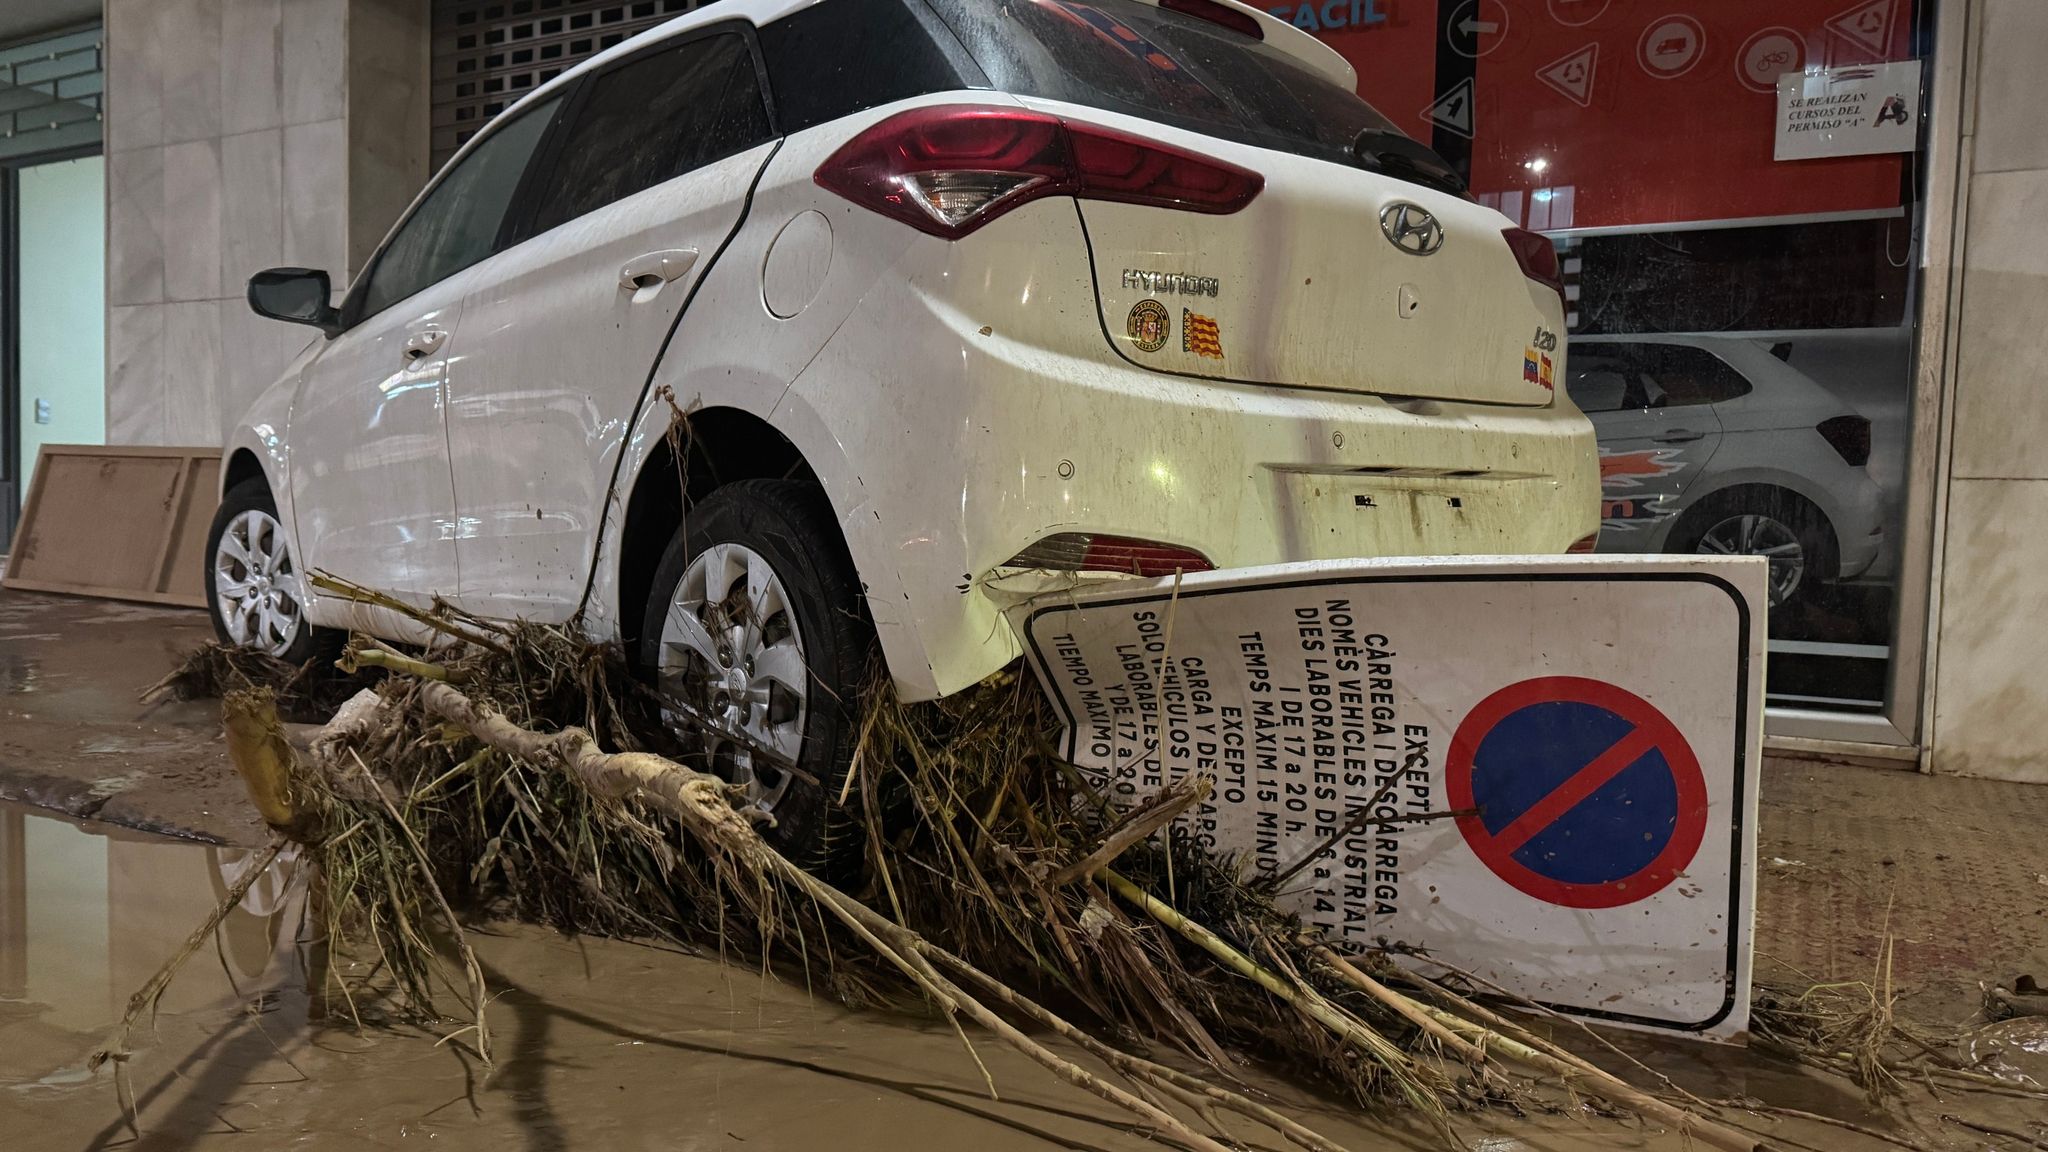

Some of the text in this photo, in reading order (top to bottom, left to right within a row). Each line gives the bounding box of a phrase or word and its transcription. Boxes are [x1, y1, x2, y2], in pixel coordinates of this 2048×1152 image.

[1788, 92, 1868, 109] SE REALIZAN
[1788, 106, 1861, 121] CURSOS DEL
[1787, 119, 1842, 132] PERMISO
[1122, 268, 1219, 298] HYUNDAI
[1133, 612, 1164, 655] SOLO
[1295, 607, 1325, 652] DIES
[1052, 633, 1093, 687] TIEMPO
[1079, 690, 1111, 758] MAXIMO
[1104, 684, 1122, 693] Y
[1181, 656, 1214, 716] CARGA
[1364, 633, 1396, 737] CÀRREGA
[1109, 695, 1134, 716] DE
[1116, 644, 1162, 787] LABORABLES DE
[1238, 631, 1272, 694] TEMPS
[1257, 782, 1278, 802] 15
[1281, 700, 1303, 727] DE
[1117, 722, 1138, 742] 17
[1196, 724, 1216, 736] Y
[1305, 658, 1337, 801] LABORABLES
[1338, 680, 1367, 788] VEHICLES
[1118, 748, 1133, 759] a
[1221, 705, 1245, 804] EXCEPTO
[1283, 737, 1306, 758] 17
[1116, 767, 1137, 796] 20
[1285, 763, 1301, 774] a
[1286, 782, 1307, 812] 20
[1285, 820, 1307, 838] h.
[1314, 808, 1337, 838] DE
[1314, 868, 1331, 879] a
[1313, 888, 1335, 914] 14
